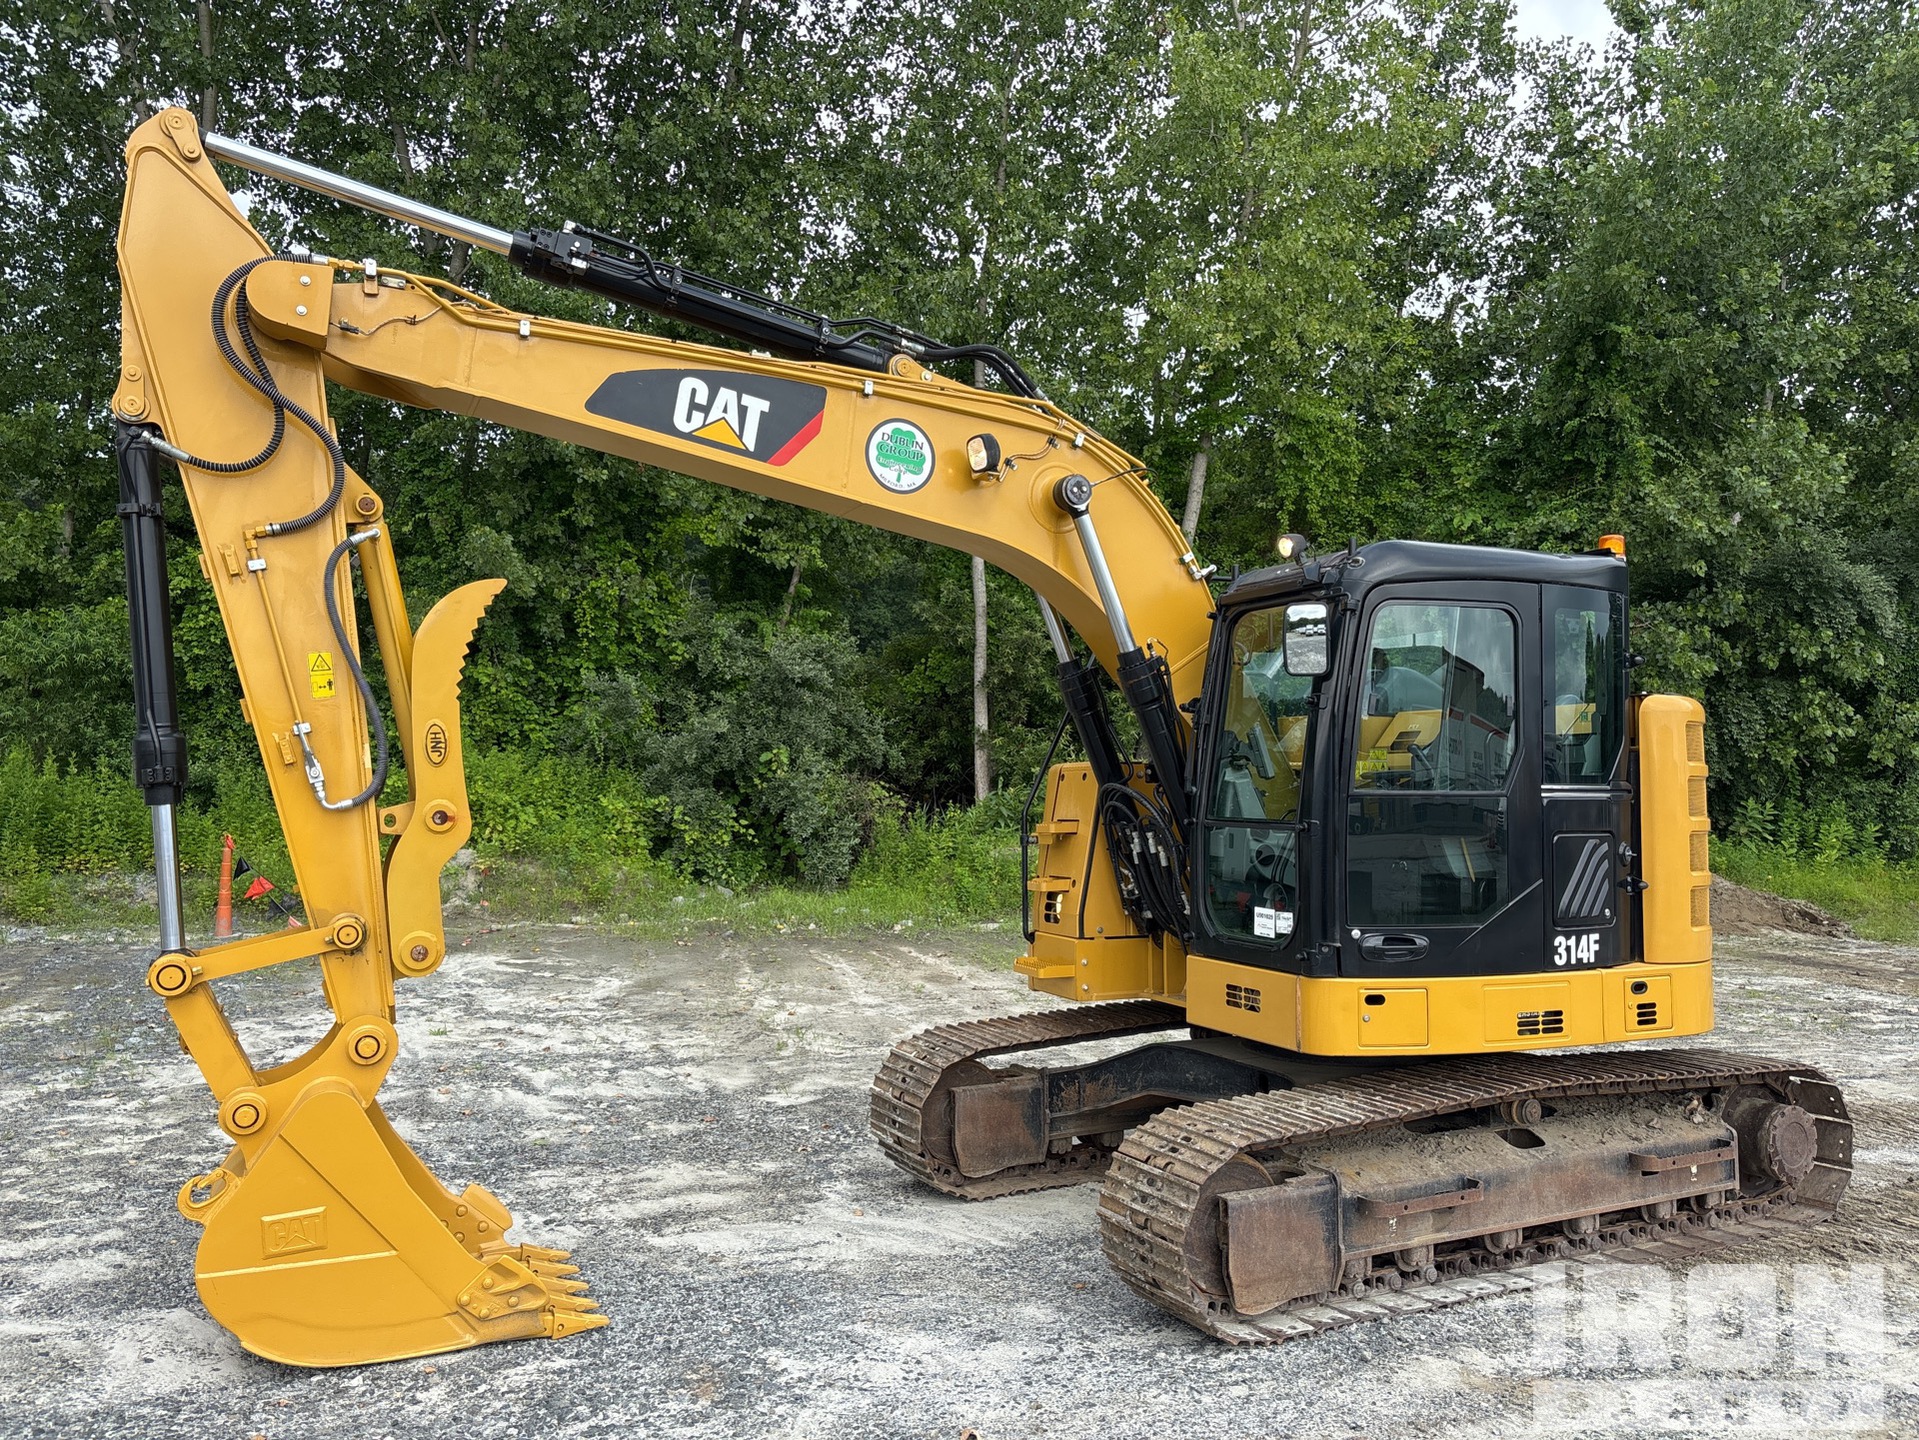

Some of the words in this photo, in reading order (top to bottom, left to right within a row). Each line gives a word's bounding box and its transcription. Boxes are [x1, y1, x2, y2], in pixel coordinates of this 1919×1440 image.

[673, 376, 771, 453] CAT
[879, 443, 923, 461] GROUP
[881, 432, 924, 451] DUBLIN
[1553, 933, 1600, 966] 314F
[267, 1214, 321, 1252] CAT
